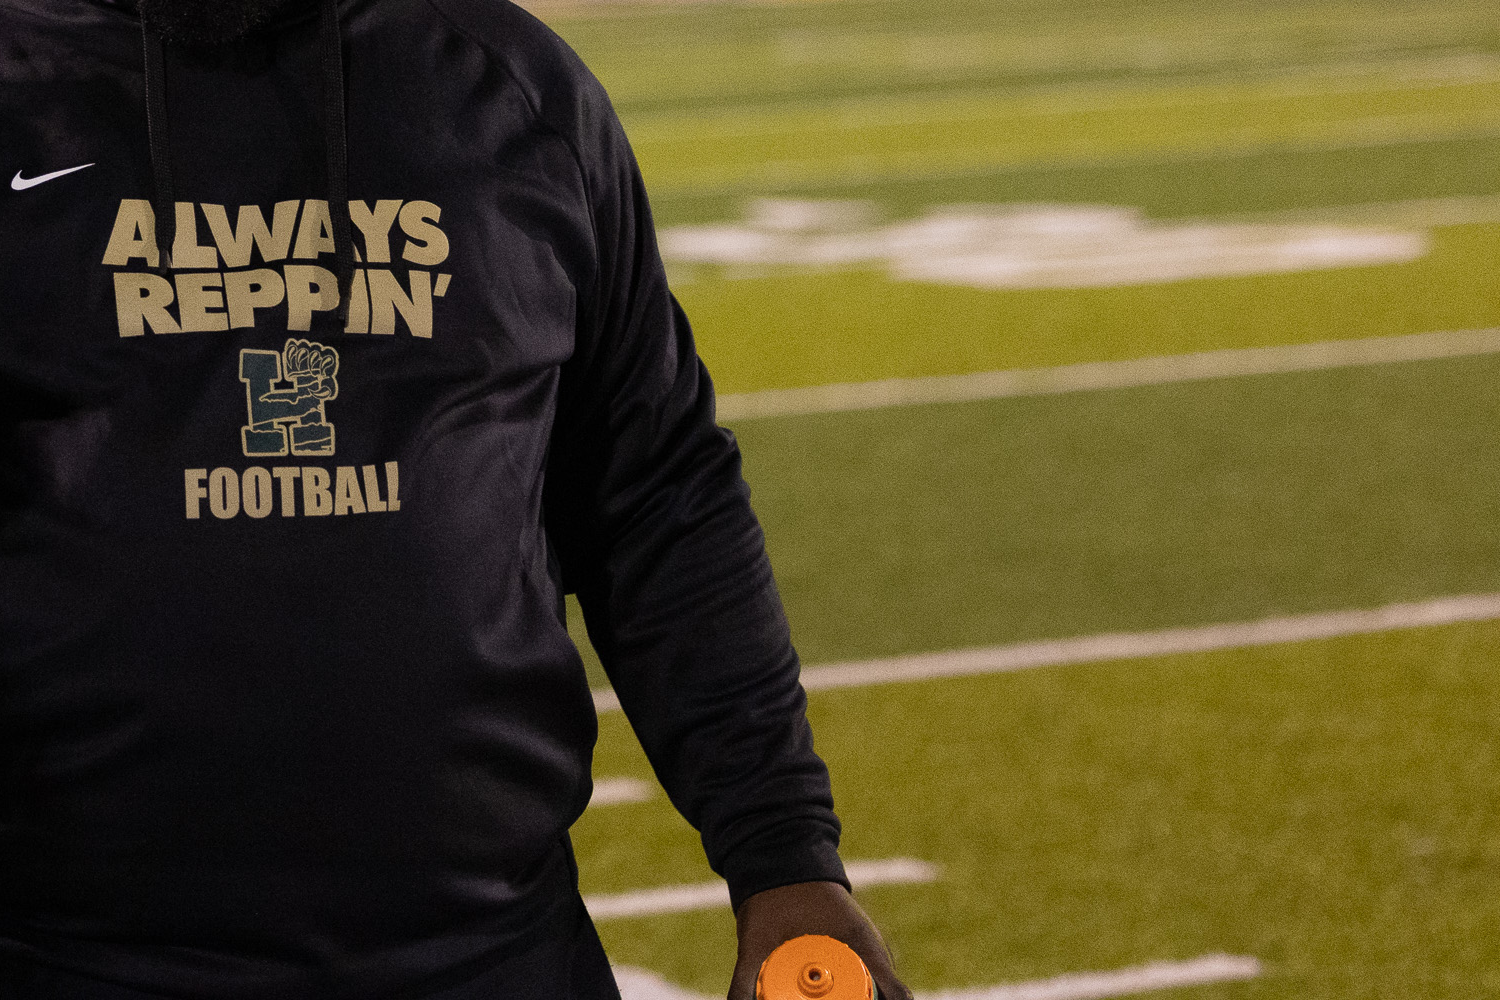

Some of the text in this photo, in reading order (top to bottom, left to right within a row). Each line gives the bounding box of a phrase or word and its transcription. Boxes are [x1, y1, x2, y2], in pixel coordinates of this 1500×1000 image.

[102, 199, 450, 268] ALWAYS
[113, 264, 452, 339] REPPIN'
[184, 461, 401, 520] FOOTBALL
